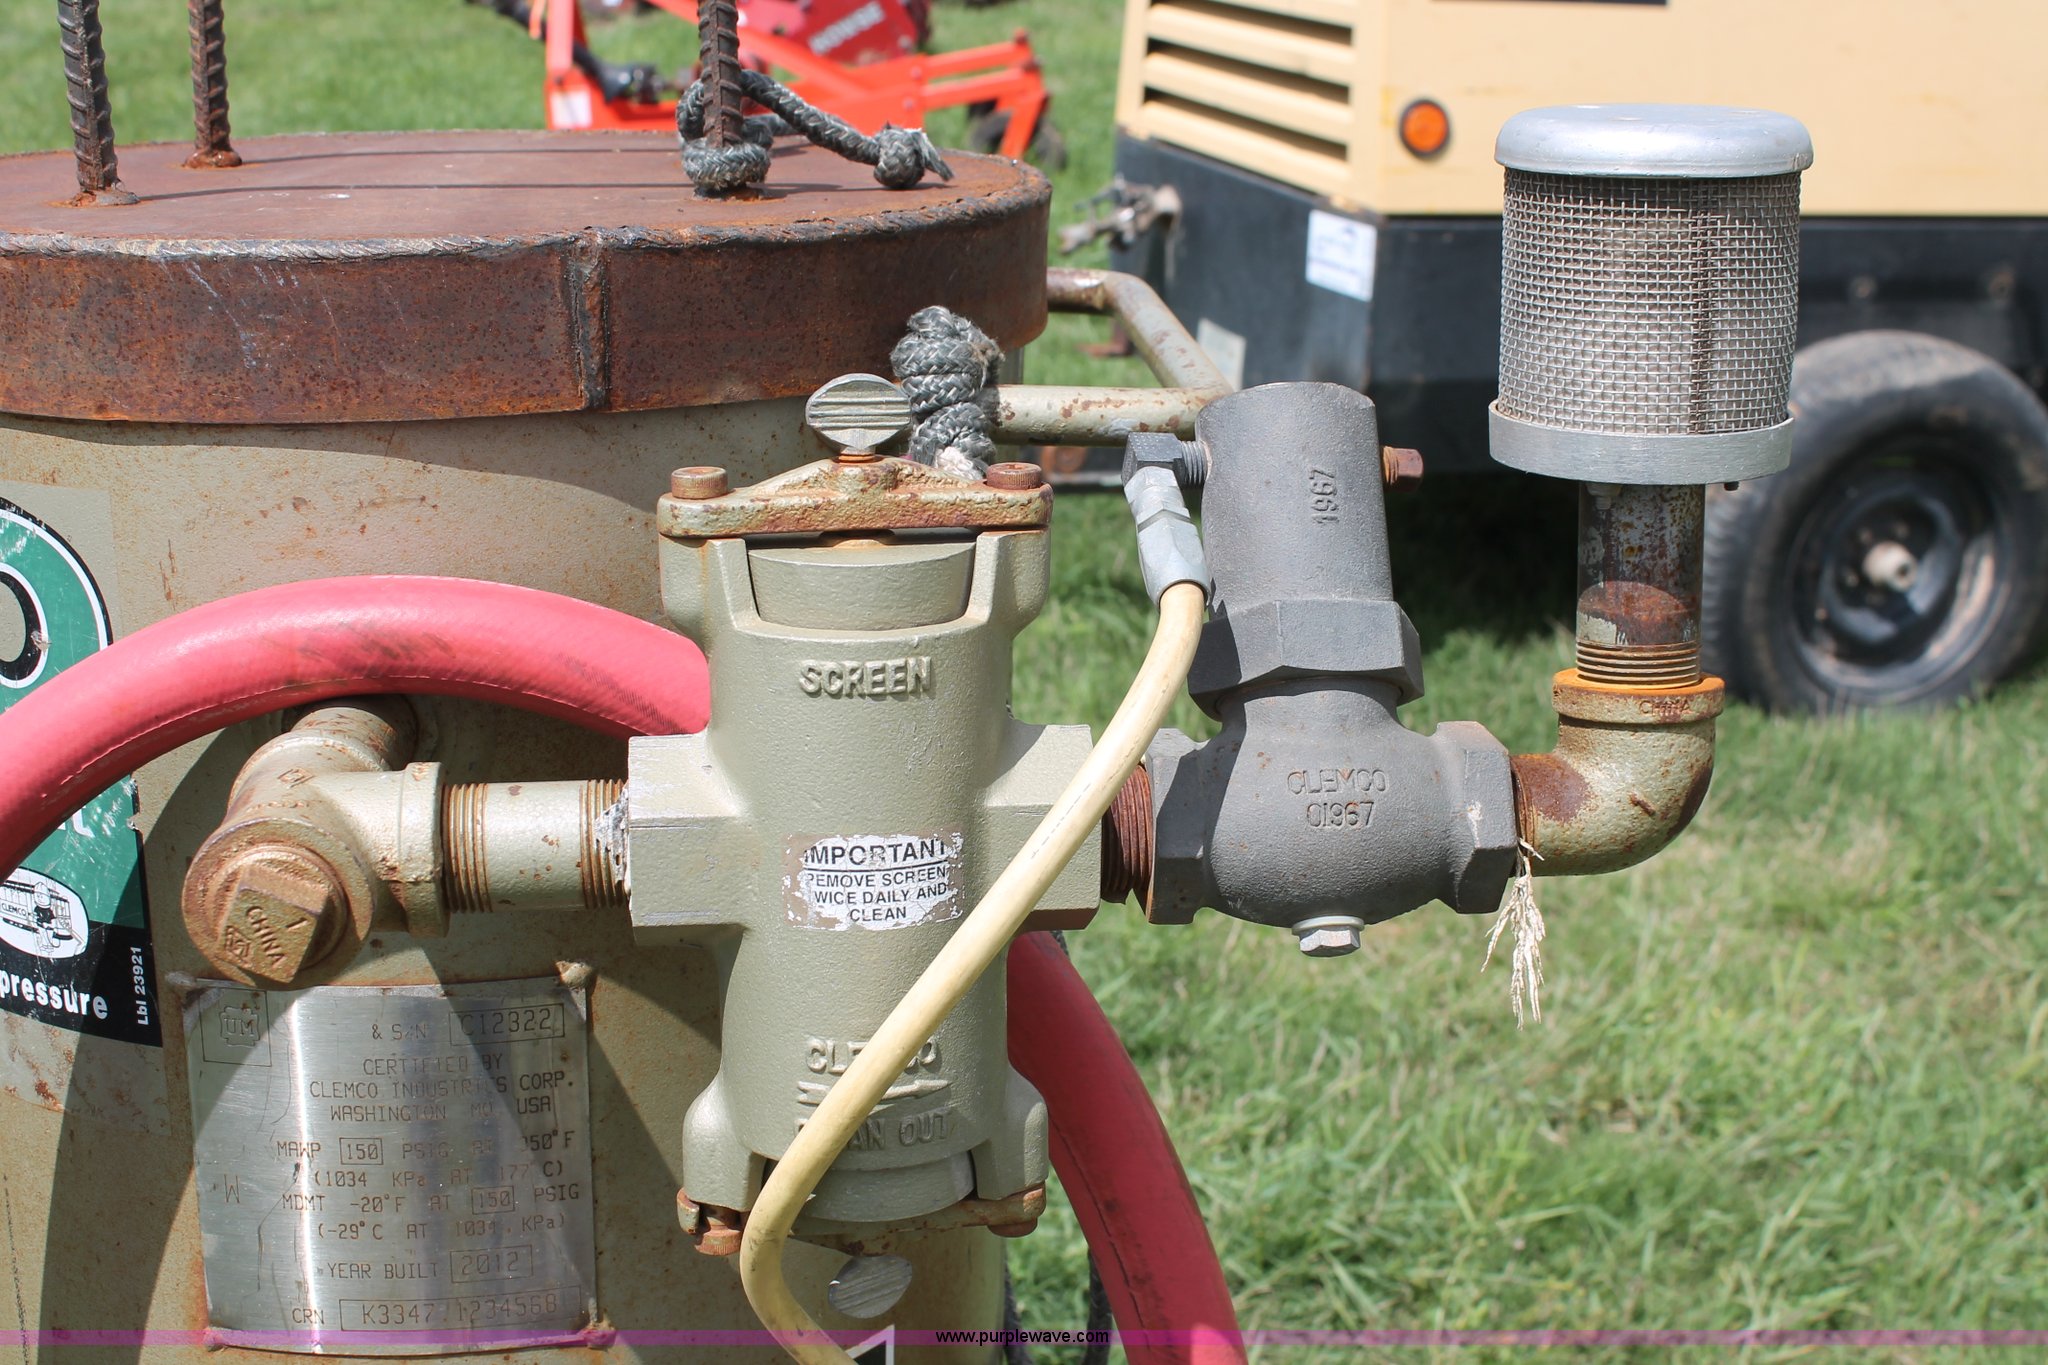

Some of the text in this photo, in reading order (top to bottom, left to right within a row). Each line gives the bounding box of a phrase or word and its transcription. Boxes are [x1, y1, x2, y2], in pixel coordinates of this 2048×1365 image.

[1309, 469, 1339, 523] 1967
[799, 656, 932, 698] SCREEN
[1287, 768, 1387, 795] CLEMCO
[882, 866, 947, 887] SCREEN
[862, 890, 910, 904] DAILY
[917, 882, 948, 900] AND
[850, 907, 907, 922] CLEAN
[246, 905, 286, 968] CHINA
[0, 969, 108, 1020] pressure
[130, 946, 150, 1026] Lbl 23921
[372, 1023, 383, 1040] &
[460, 1008, 551, 1036] C12322
[363, 1053, 503, 1076] CERTIFIED BY
[806, 1037, 938, 1072] CLEO
[310, 1081, 378, 1099] CLEMCO
[520, 1070, 574, 1091] CORP.
[331, 1104, 447, 1122] WASHINGTON
[517, 1095, 551, 1115] USA
[899, 1109, 951, 1147] OUT
[277, 1141, 322, 1158] MAWP
[347, 1143, 378, 1160] 150
[402, 1141, 449, 1160] PSIG
[315, 1171, 367, 1187] (1034
[392, 1171, 426, 1187] KPa
[451, 1168, 472, 1185] AT
[282, 1194, 325, 1211] MDMT
[430, 1194, 451, 1211] AT
[479, 1190, 511, 1209] 150
[533, 1183, 579, 1203] PSIG
[407, 1223, 428, 1239] AT
[522, 1213, 565, 1232] KPa)
[328, 1251, 519, 1279] YEAR BUILT 2012
[292, 1308, 325, 1325] CRN
